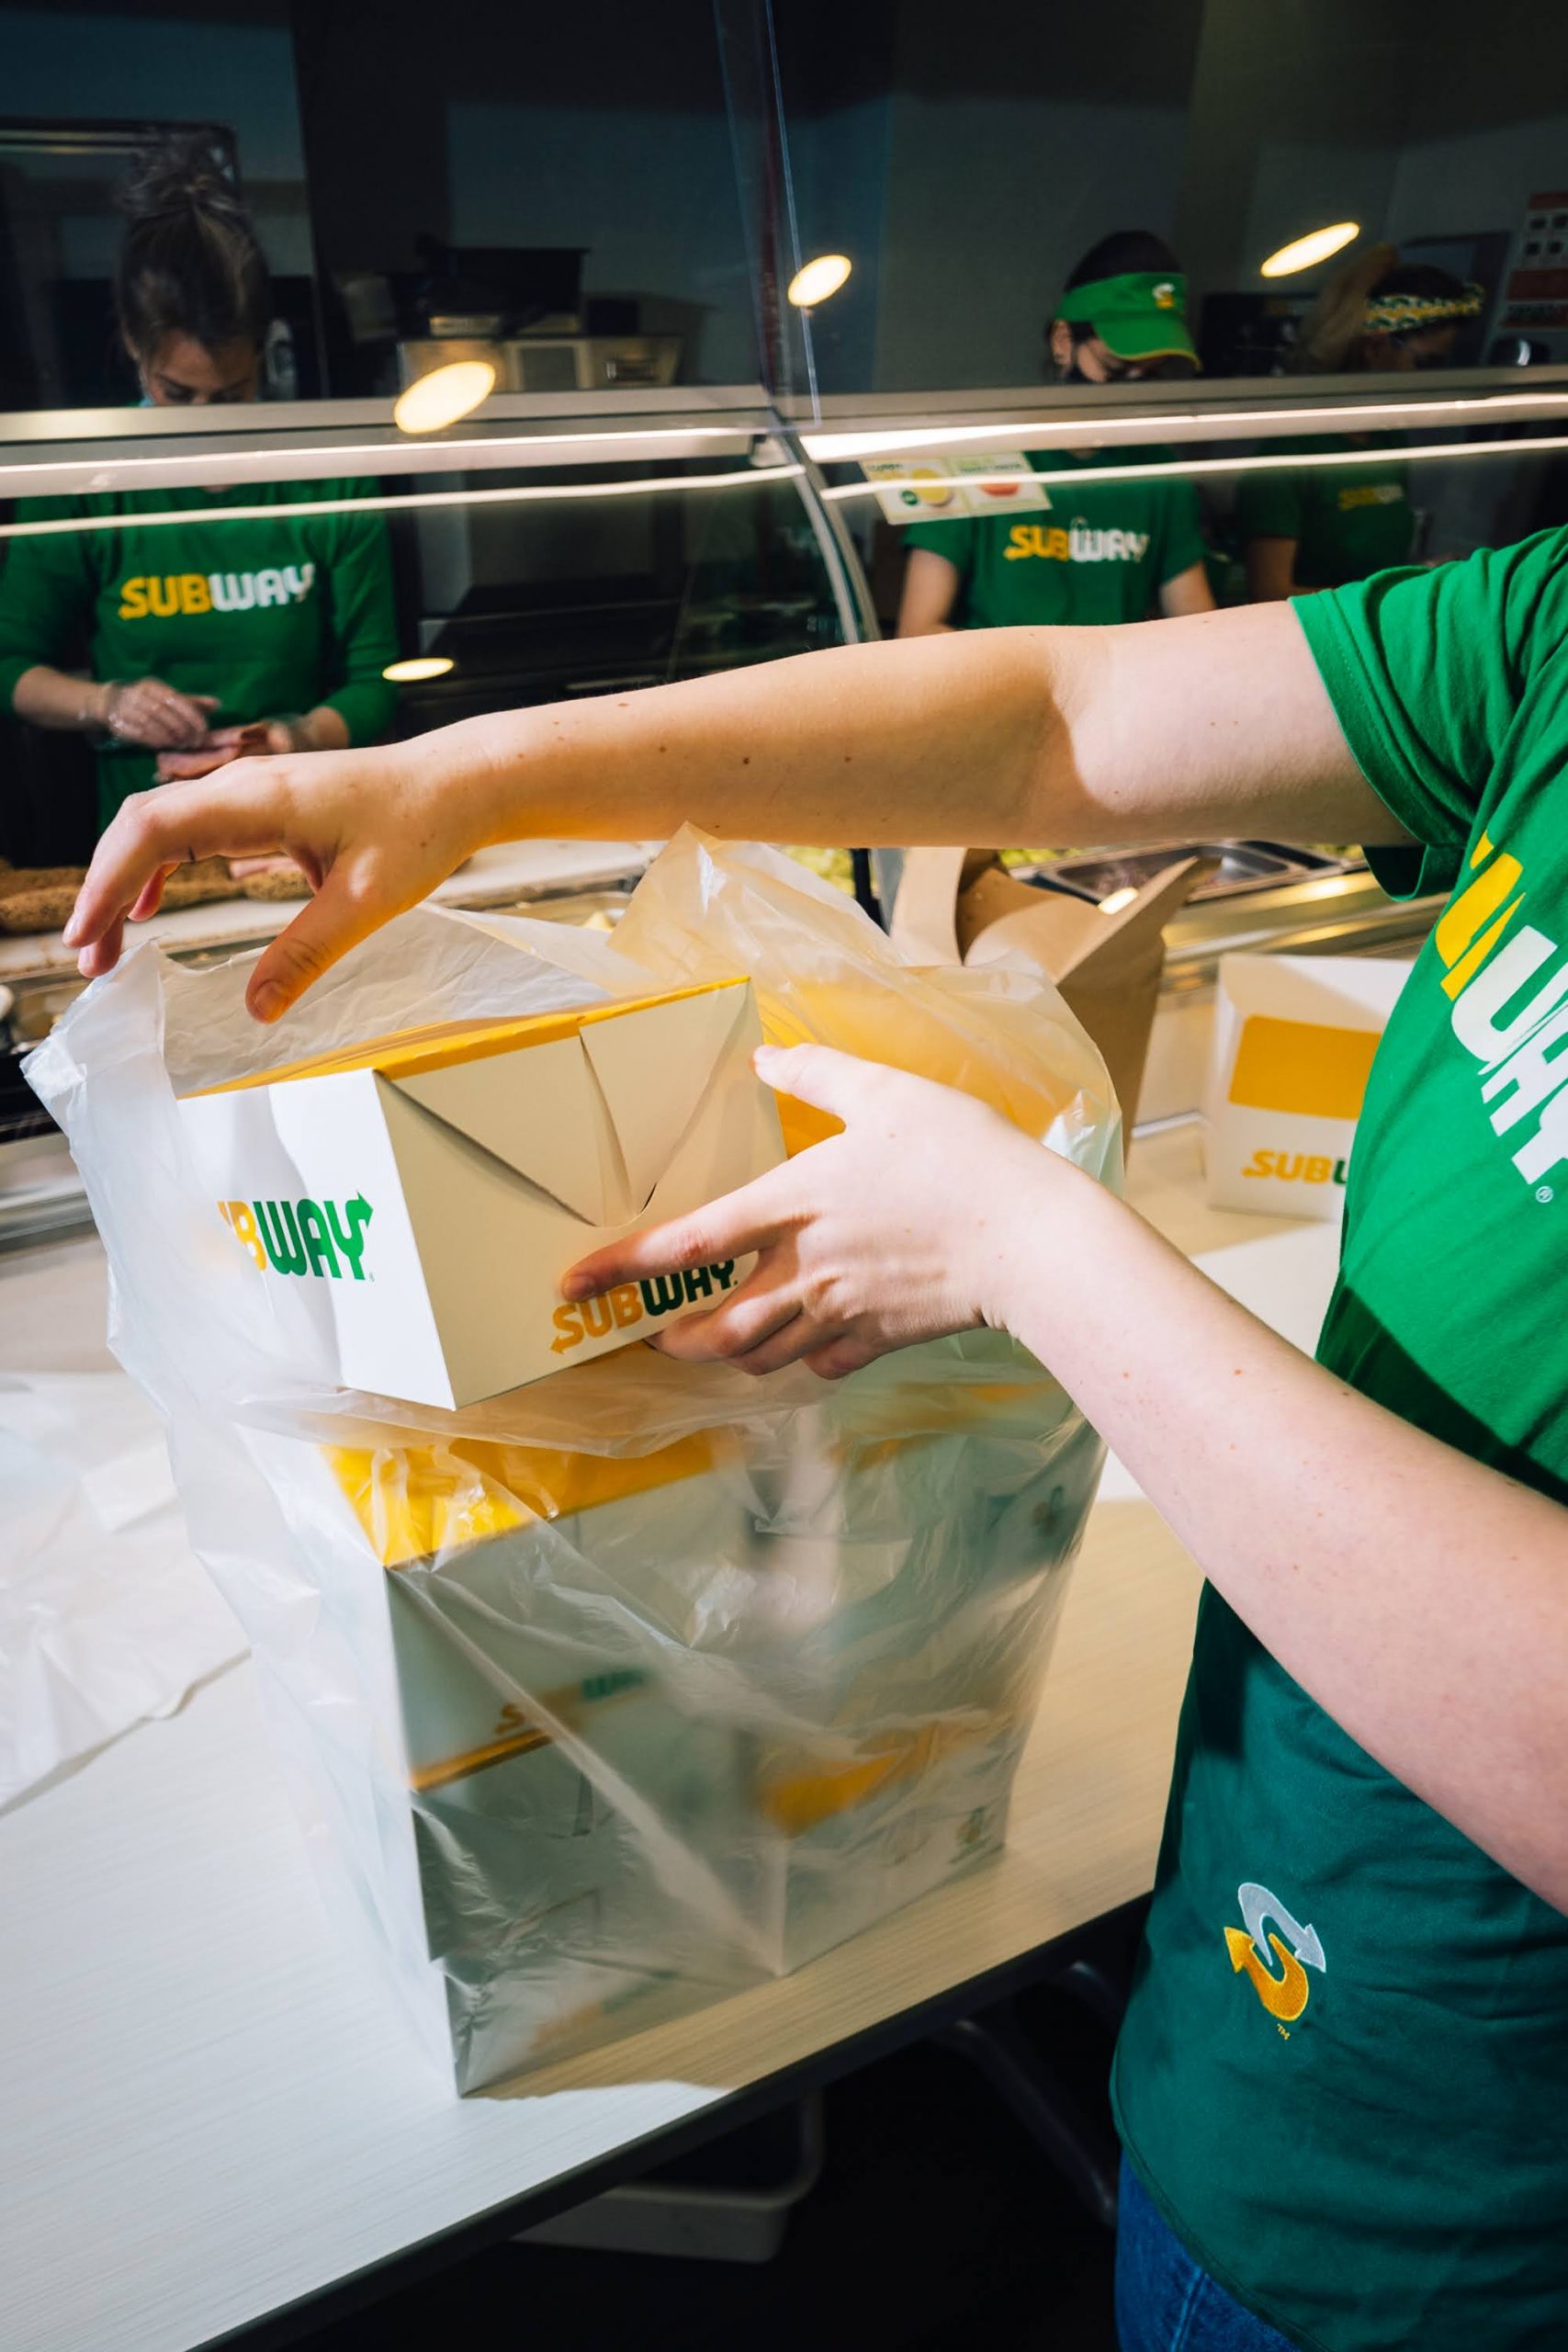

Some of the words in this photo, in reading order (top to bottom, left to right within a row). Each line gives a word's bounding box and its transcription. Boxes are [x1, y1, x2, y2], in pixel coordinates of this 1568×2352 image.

[1004, 524, 1149, 563] SUBWAY
[118, 562, 316, 620] SUBWAY
[549, 1258, 736, 1354] SUBWAY
